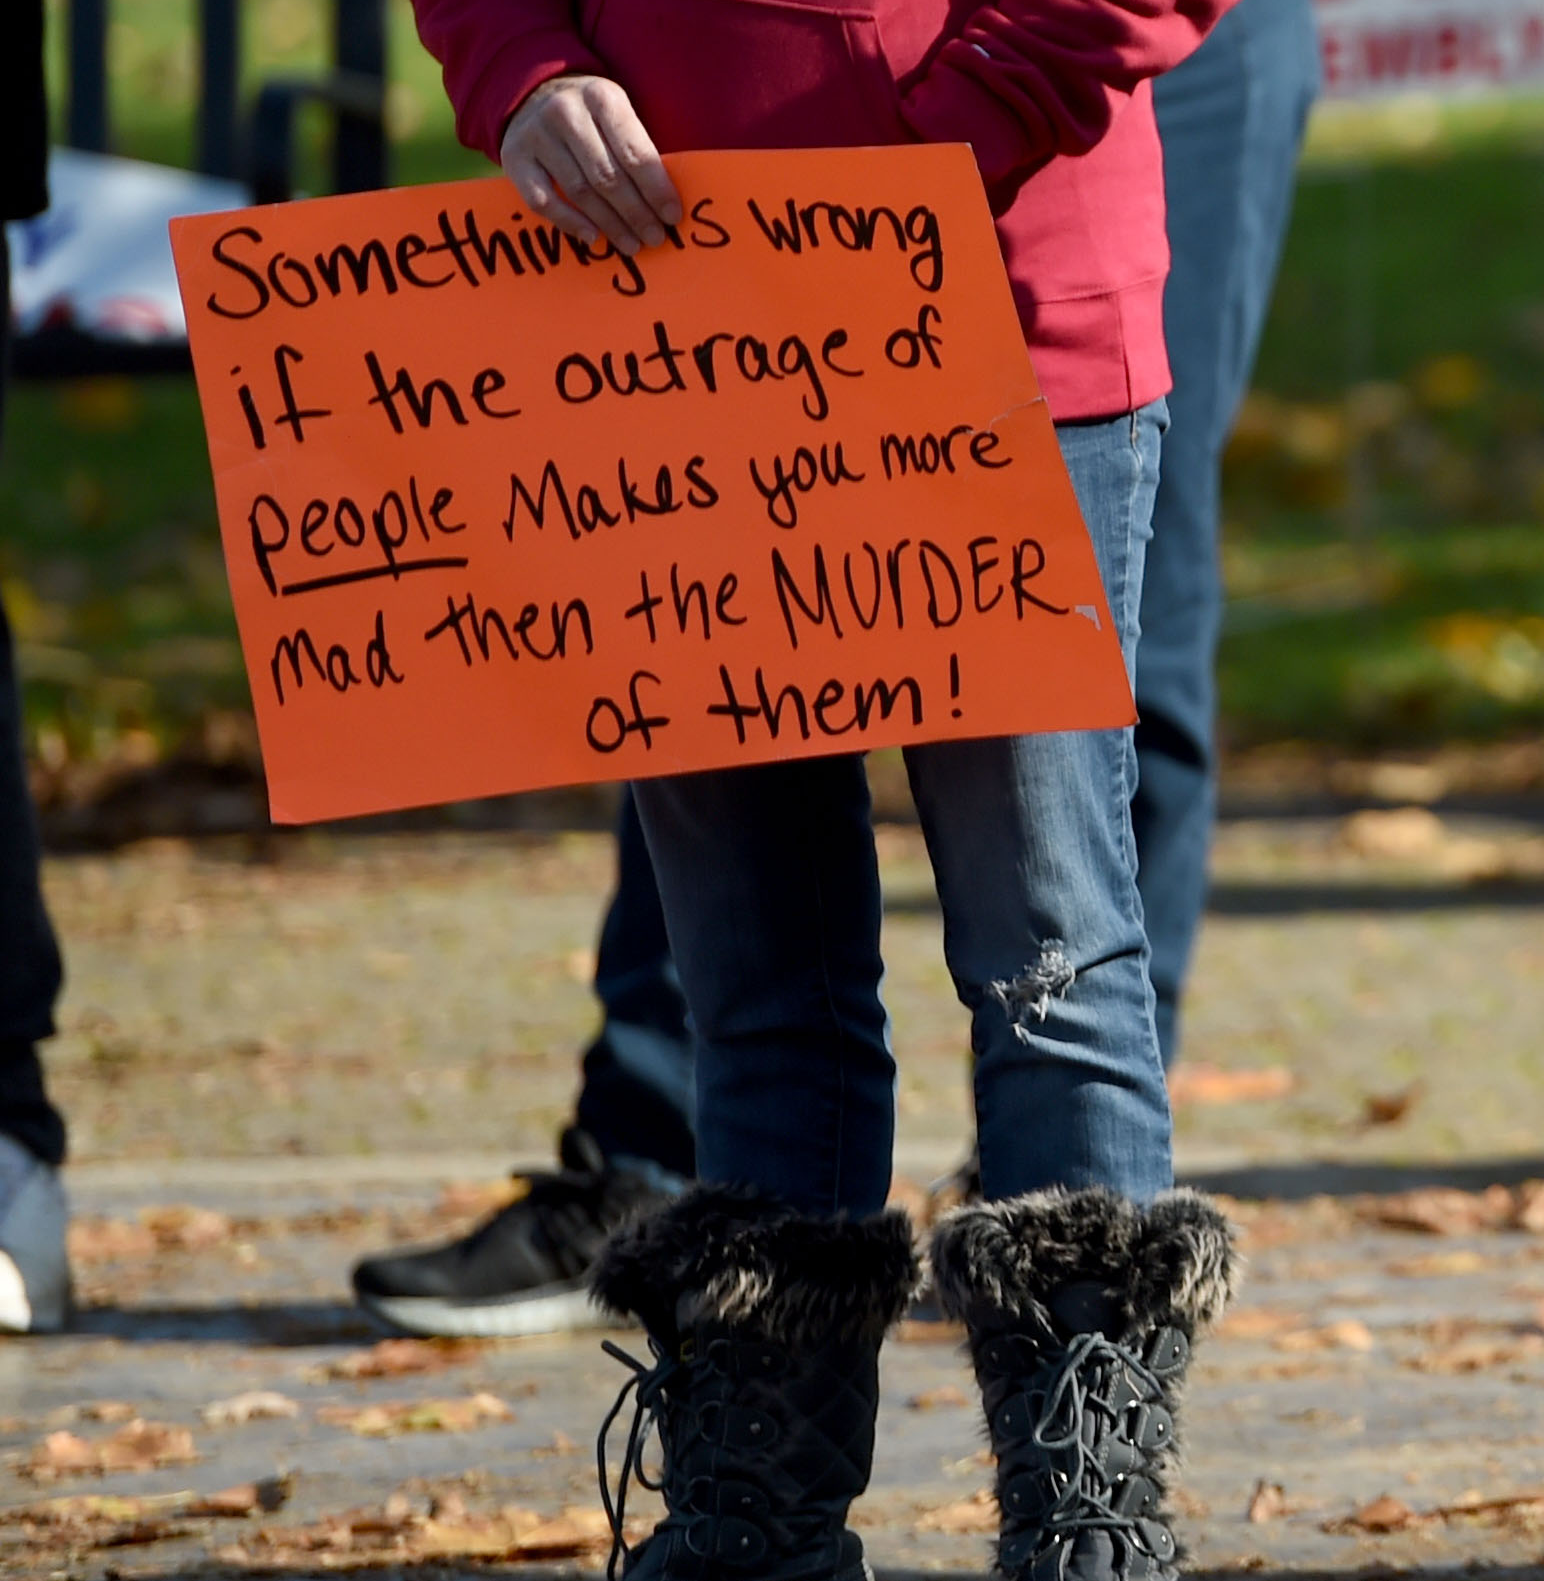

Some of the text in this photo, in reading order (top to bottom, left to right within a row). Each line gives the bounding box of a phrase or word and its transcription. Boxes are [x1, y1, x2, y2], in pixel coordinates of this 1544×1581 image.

[230, 304, 943, 450] if the outrage of
[749, 441, 866, 529] you
[881, 425, 1014, 481] more
[424, 593, 594, 666] then
[625, 568, 748, 644] the
[586, 669, 671, 754] of
